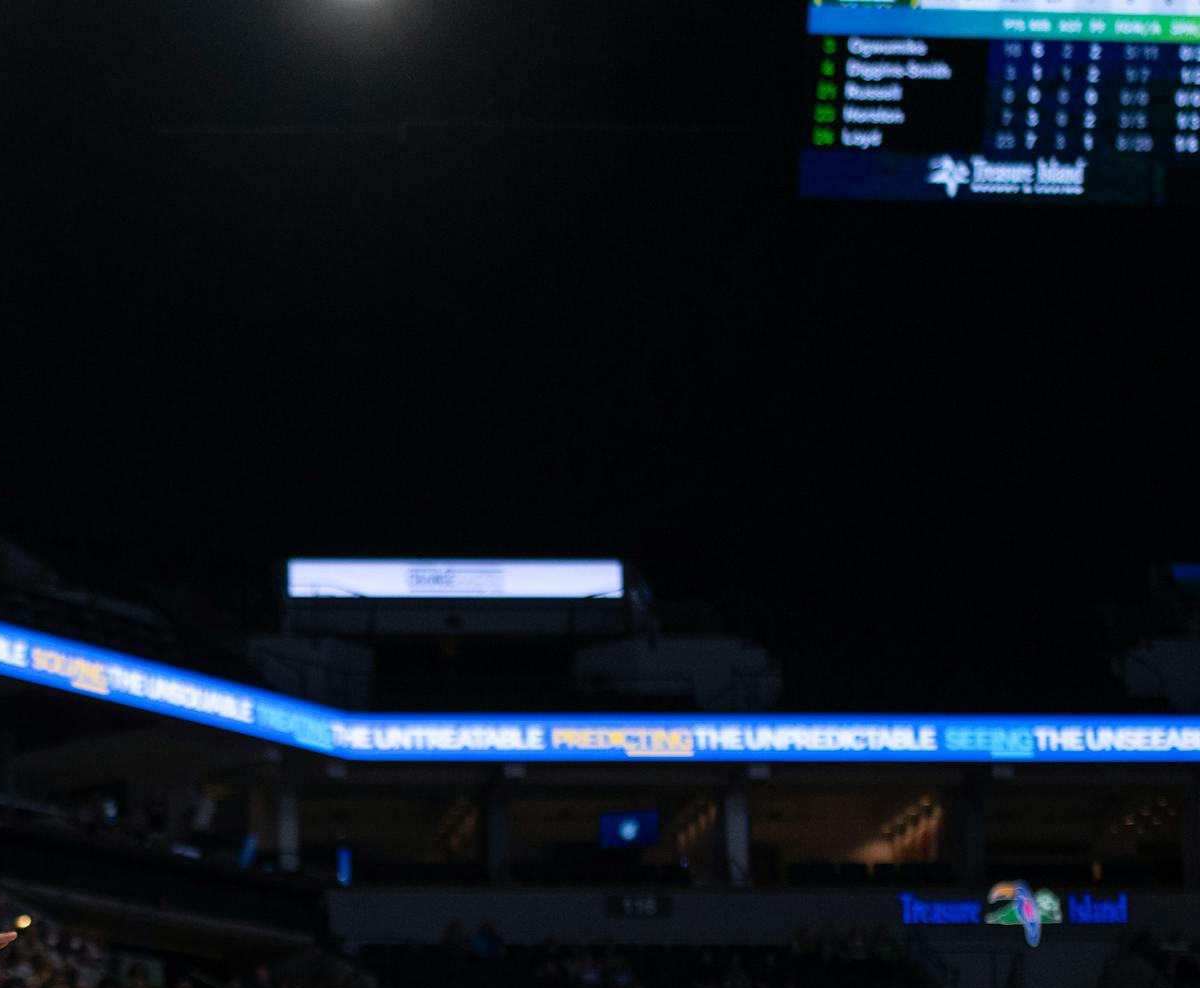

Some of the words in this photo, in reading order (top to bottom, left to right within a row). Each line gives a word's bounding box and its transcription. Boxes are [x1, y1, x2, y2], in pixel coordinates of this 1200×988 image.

[695, 725, 744, 751] THE
[745, 725, 937, 751] UNPREDICTABLE
[1034, 726, 1085, 751] THE
